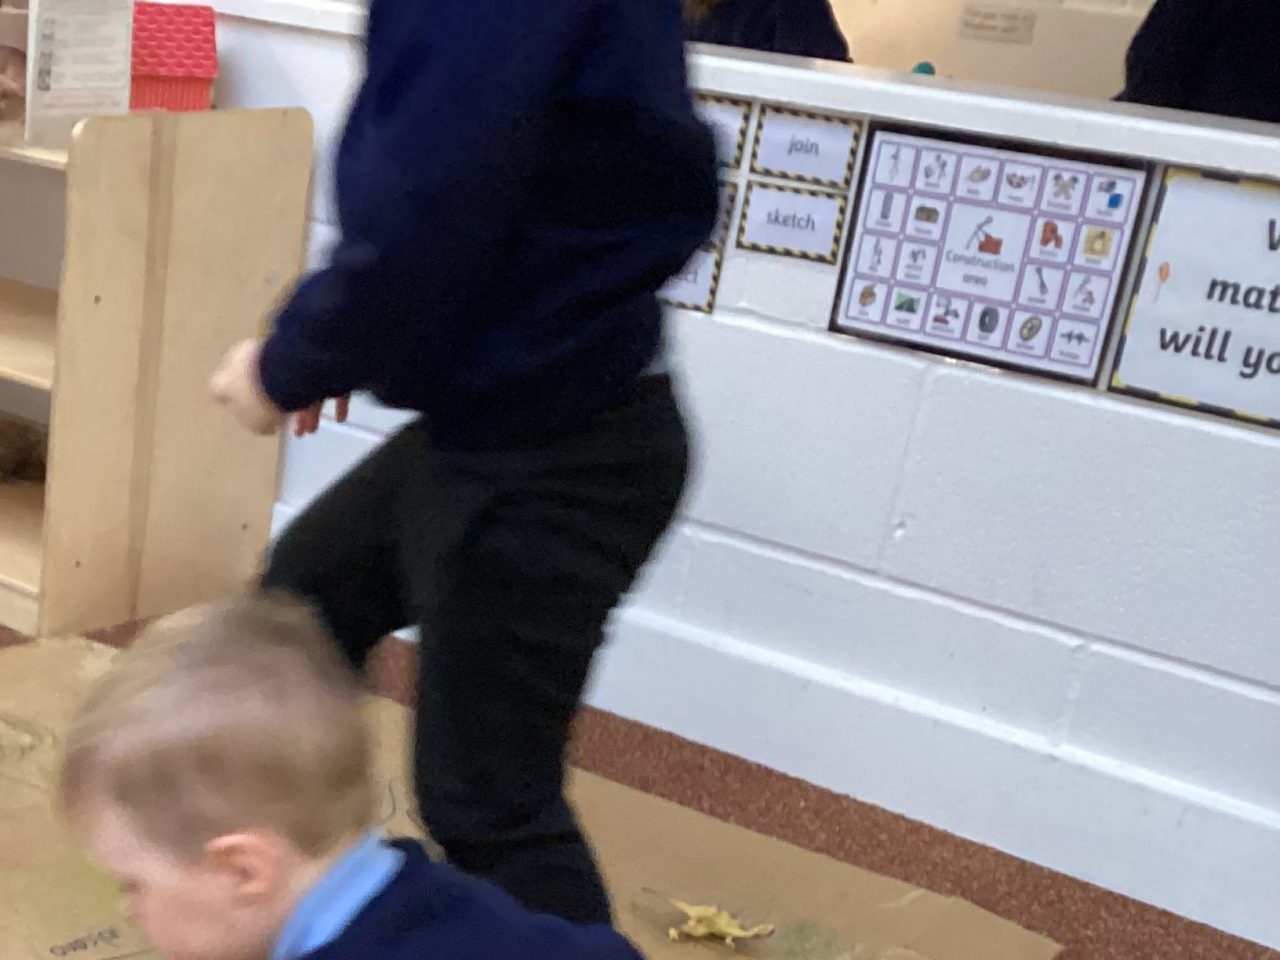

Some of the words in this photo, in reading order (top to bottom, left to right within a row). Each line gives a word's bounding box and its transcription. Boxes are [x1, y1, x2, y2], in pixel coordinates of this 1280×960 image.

[787, 133, 820, 157] join
[766, 207, 816, 232] sketch
[945, 249, 1016, 273] Construction
[1159, 325, 1232, 363] will
